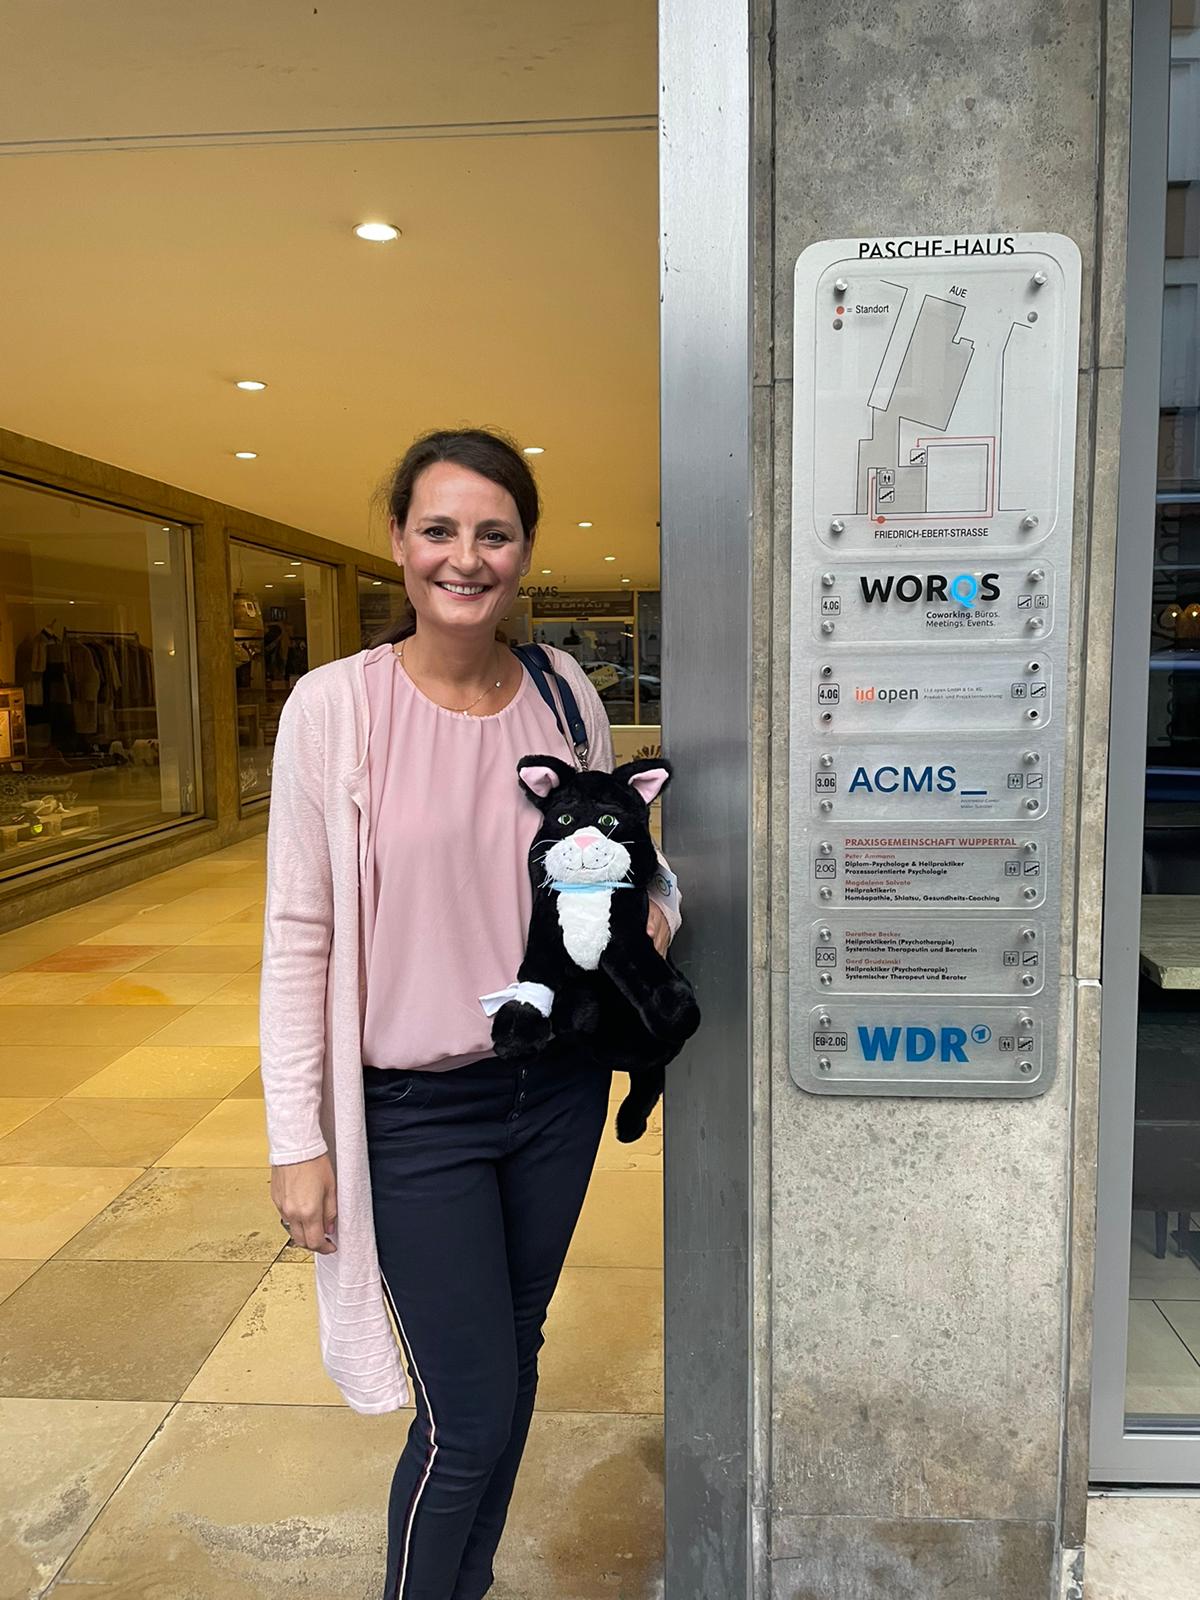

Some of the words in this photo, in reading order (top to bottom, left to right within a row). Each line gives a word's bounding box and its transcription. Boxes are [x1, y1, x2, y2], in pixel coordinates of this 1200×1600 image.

[859, 237, 1015, 259] PASCHE-HAUS
[949, 285, 968, 298] AUE
[855, 304, 889, 314] Standort
[874, 527, 989, 539] FRIEDRICH-EBERT-STRASSE
[860, 573, 1000, 609] WORQS
[926, 611, 973, 619] Coworking.
[975, 610, 1000, 618] Büros.
[926, 620, 965, 628] Meetings.
[878, 689, 919, 703] open
[845, 838, 956, 846] PRAXISGEMEINSCHAFT
[960, 838, 1017, 846] WUPPERTAL
[891, 966, 948, 974] (Psychotherapie)
[857, 1026, 969, 1062] WDR
